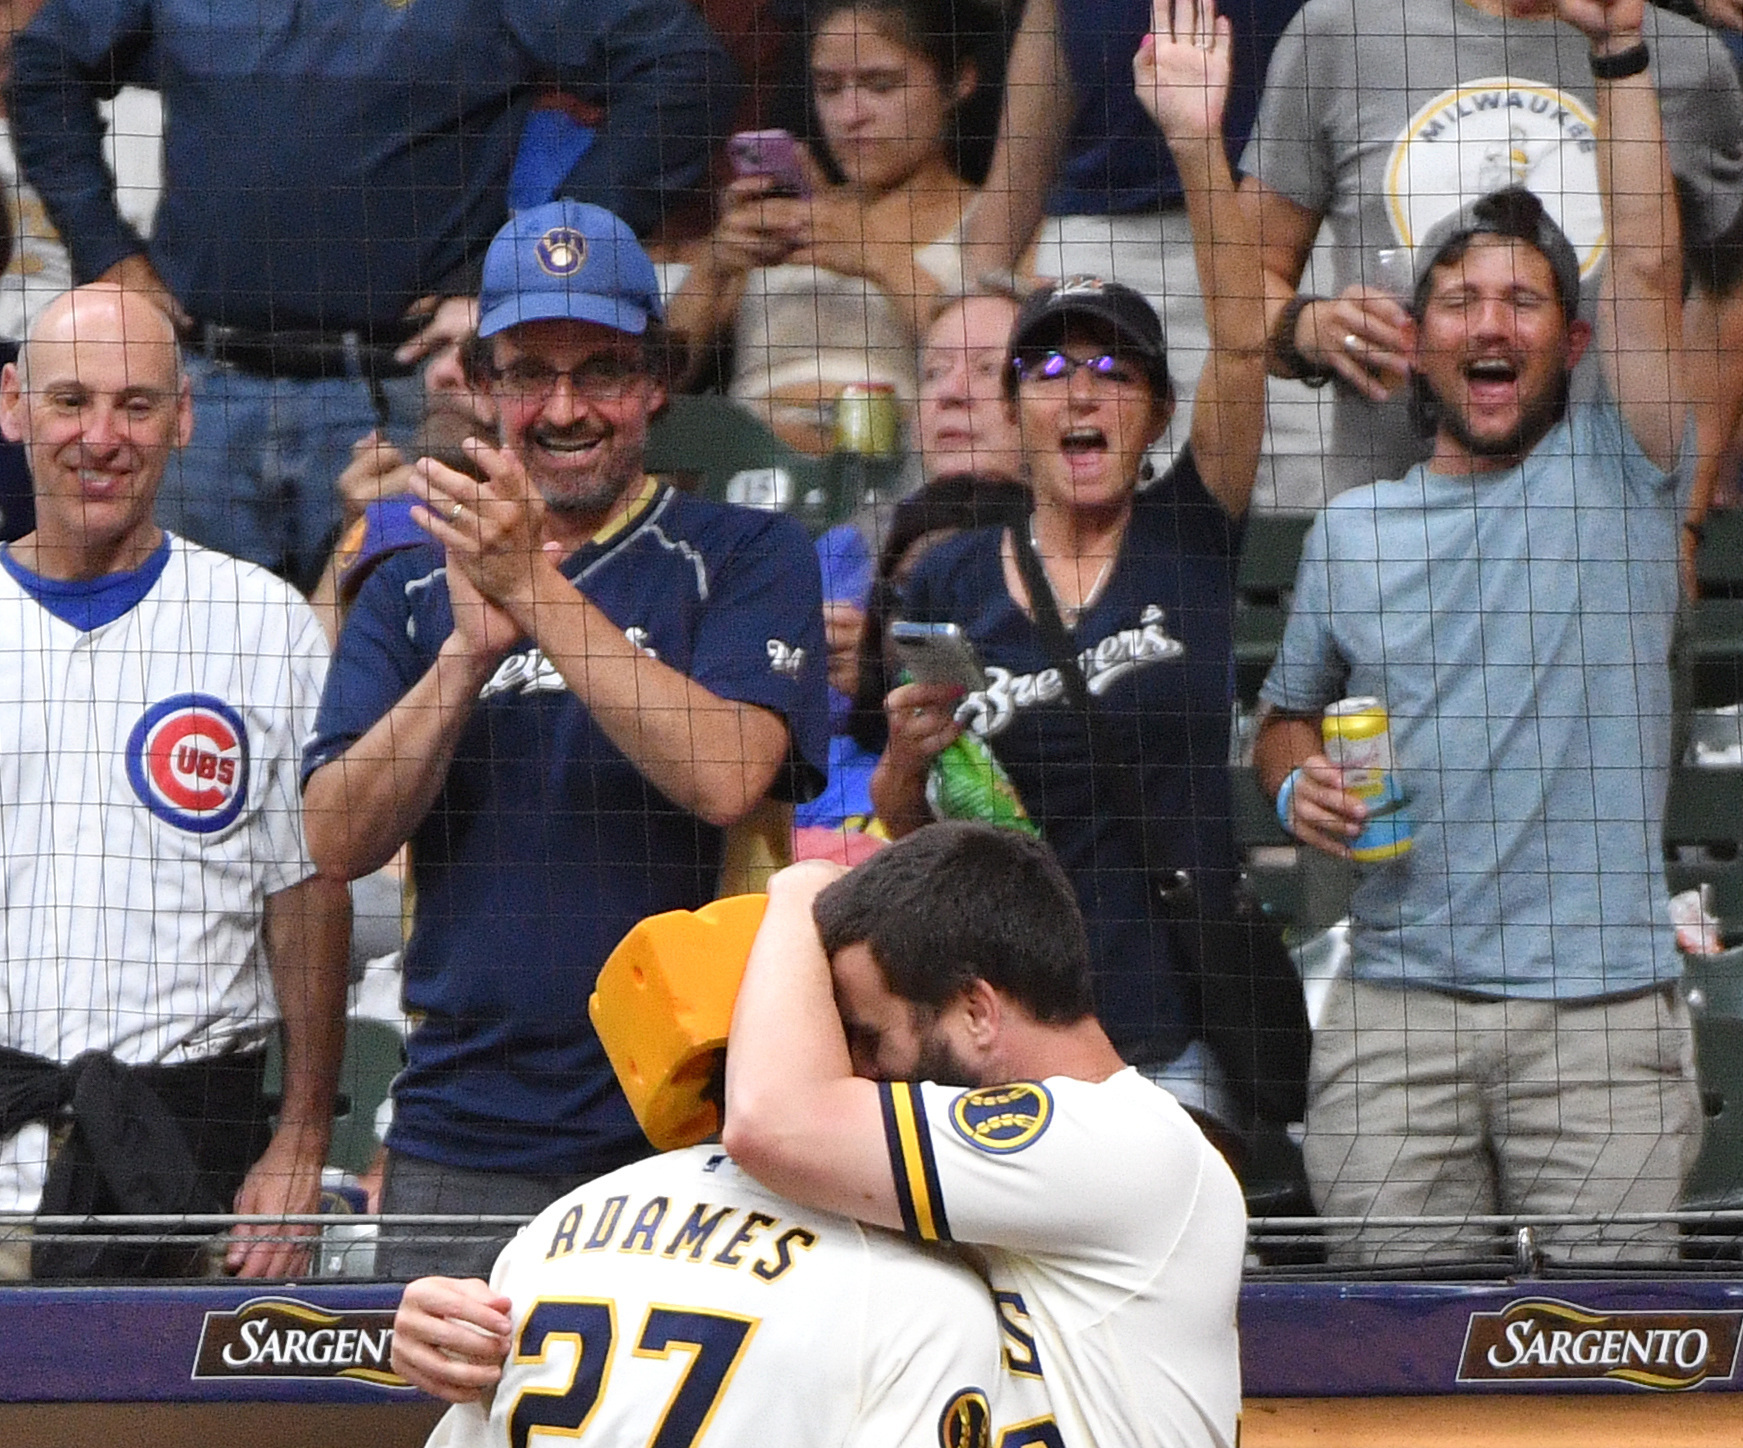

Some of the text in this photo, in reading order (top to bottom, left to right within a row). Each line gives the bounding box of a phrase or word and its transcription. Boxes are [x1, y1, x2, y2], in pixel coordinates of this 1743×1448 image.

[1419, 92, 1594, 154] MILWAUKEE
[543, 1195, 820, 1285] ADAMES
[222, 1318, 397, 1368] SARGEN
[1488, 1319, 1709, 1369] SARGENTO
